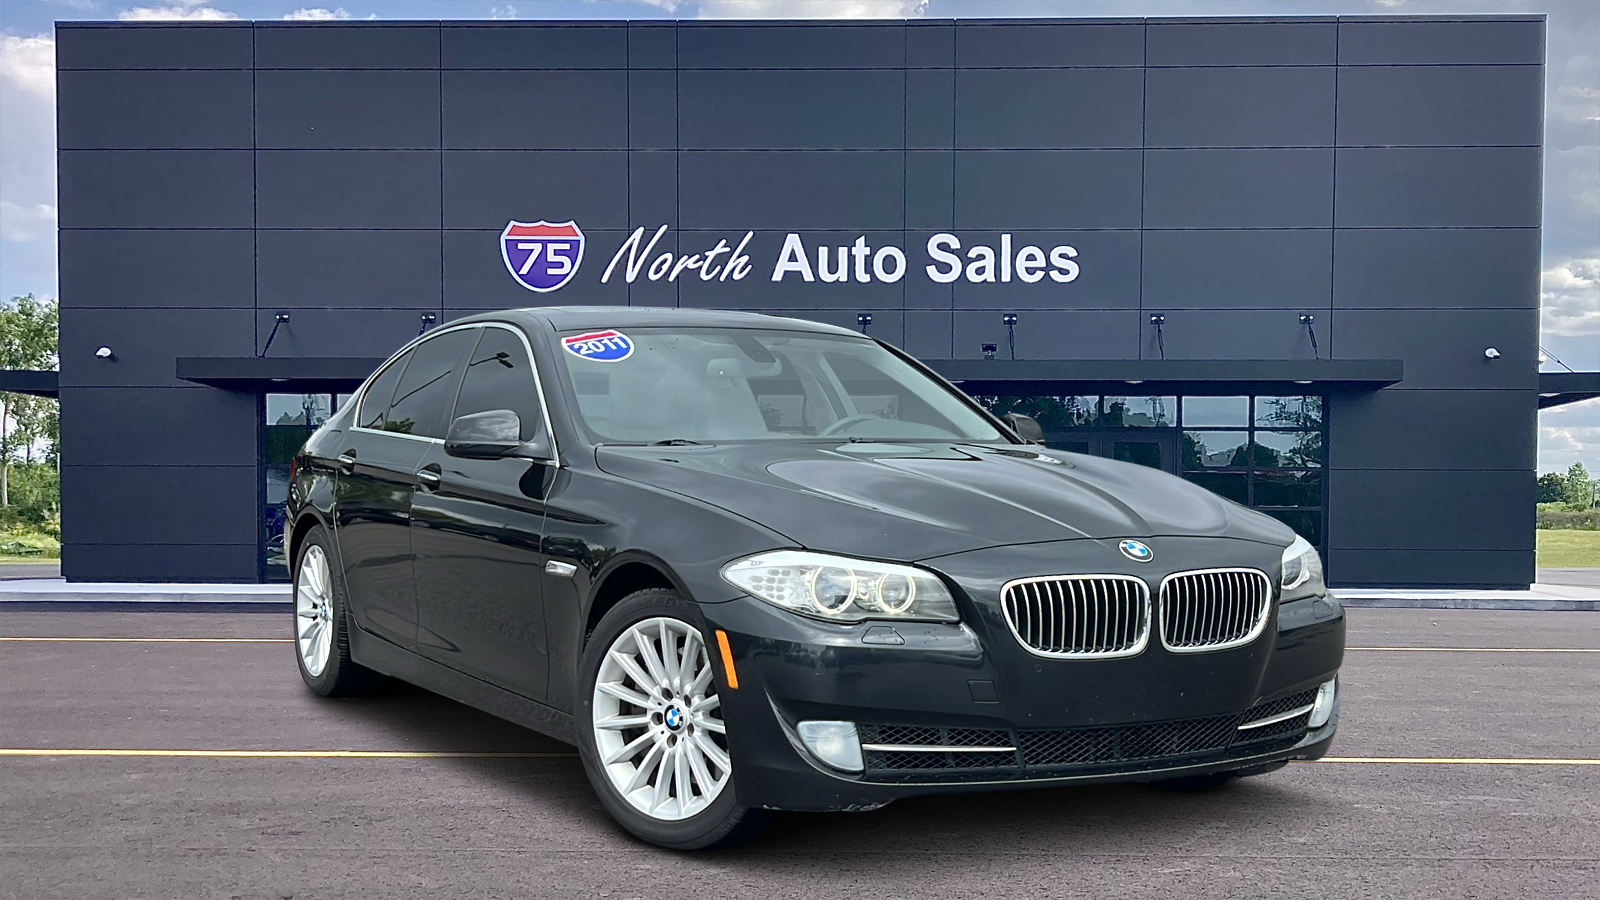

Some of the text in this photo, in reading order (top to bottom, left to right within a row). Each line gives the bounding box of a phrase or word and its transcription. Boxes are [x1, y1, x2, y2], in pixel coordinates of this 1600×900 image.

[517, 224, 1080, 284] 75 North Auto Sales
[573, 337, 628, 355] 2011
